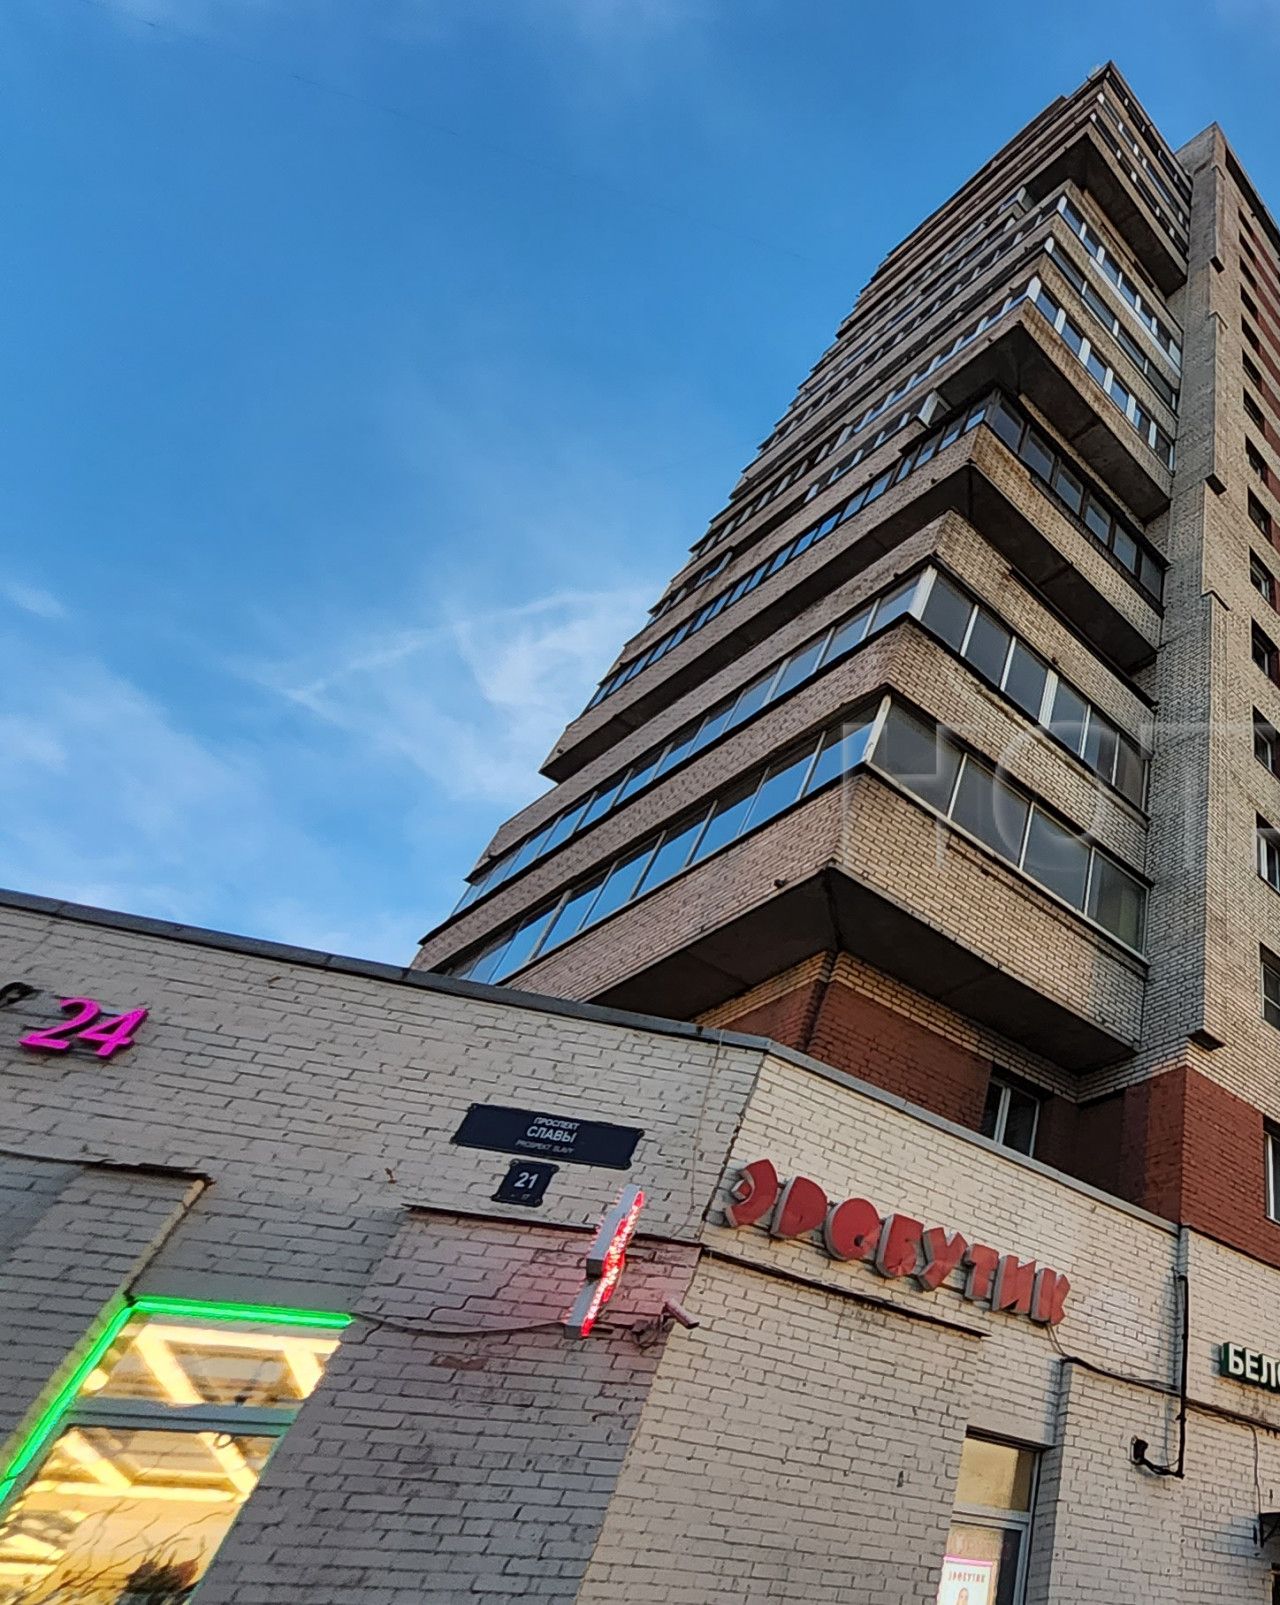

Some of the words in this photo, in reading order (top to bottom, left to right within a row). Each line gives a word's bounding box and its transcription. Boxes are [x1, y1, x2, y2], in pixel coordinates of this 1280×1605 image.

[19, 997, 149, 1059] 24
[534, 1117, 580, 1131] ПРОСПЕКТ
[526, 1125, 577, 1143] СЛАВЫ
[513, 1171, 539, 1190] 21
[724, 1158, 1072, 1326] ЭРОБУТИК
